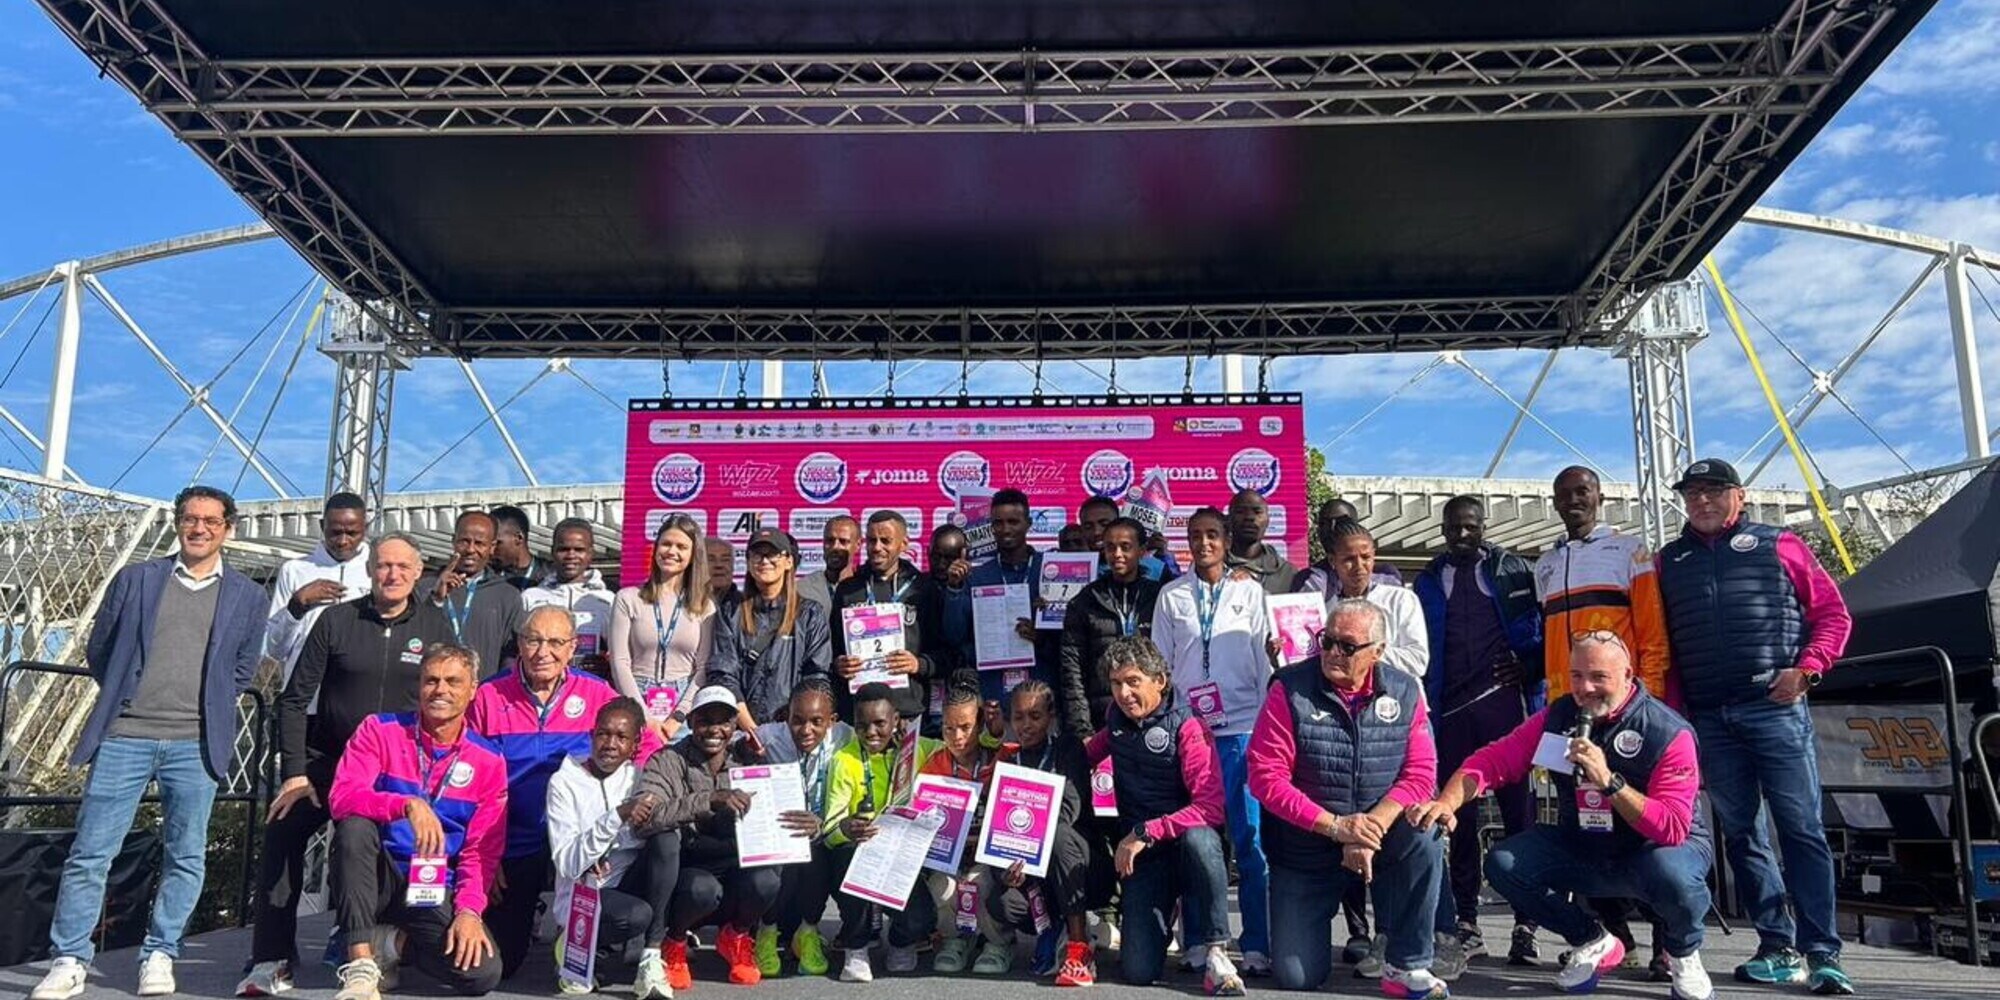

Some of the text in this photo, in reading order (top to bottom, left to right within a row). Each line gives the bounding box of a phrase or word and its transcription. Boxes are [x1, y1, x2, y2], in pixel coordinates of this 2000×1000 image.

[661, 471, 694, 480] VENICE
[1090, 467, 1123, 475] VENICE
[1236, 466, 1269, 474] VENICE
[1130, 505, 1159, 525] MOSES
[1062, 584, 1069, 597] 7
[874, 639, 882, 652] 2
